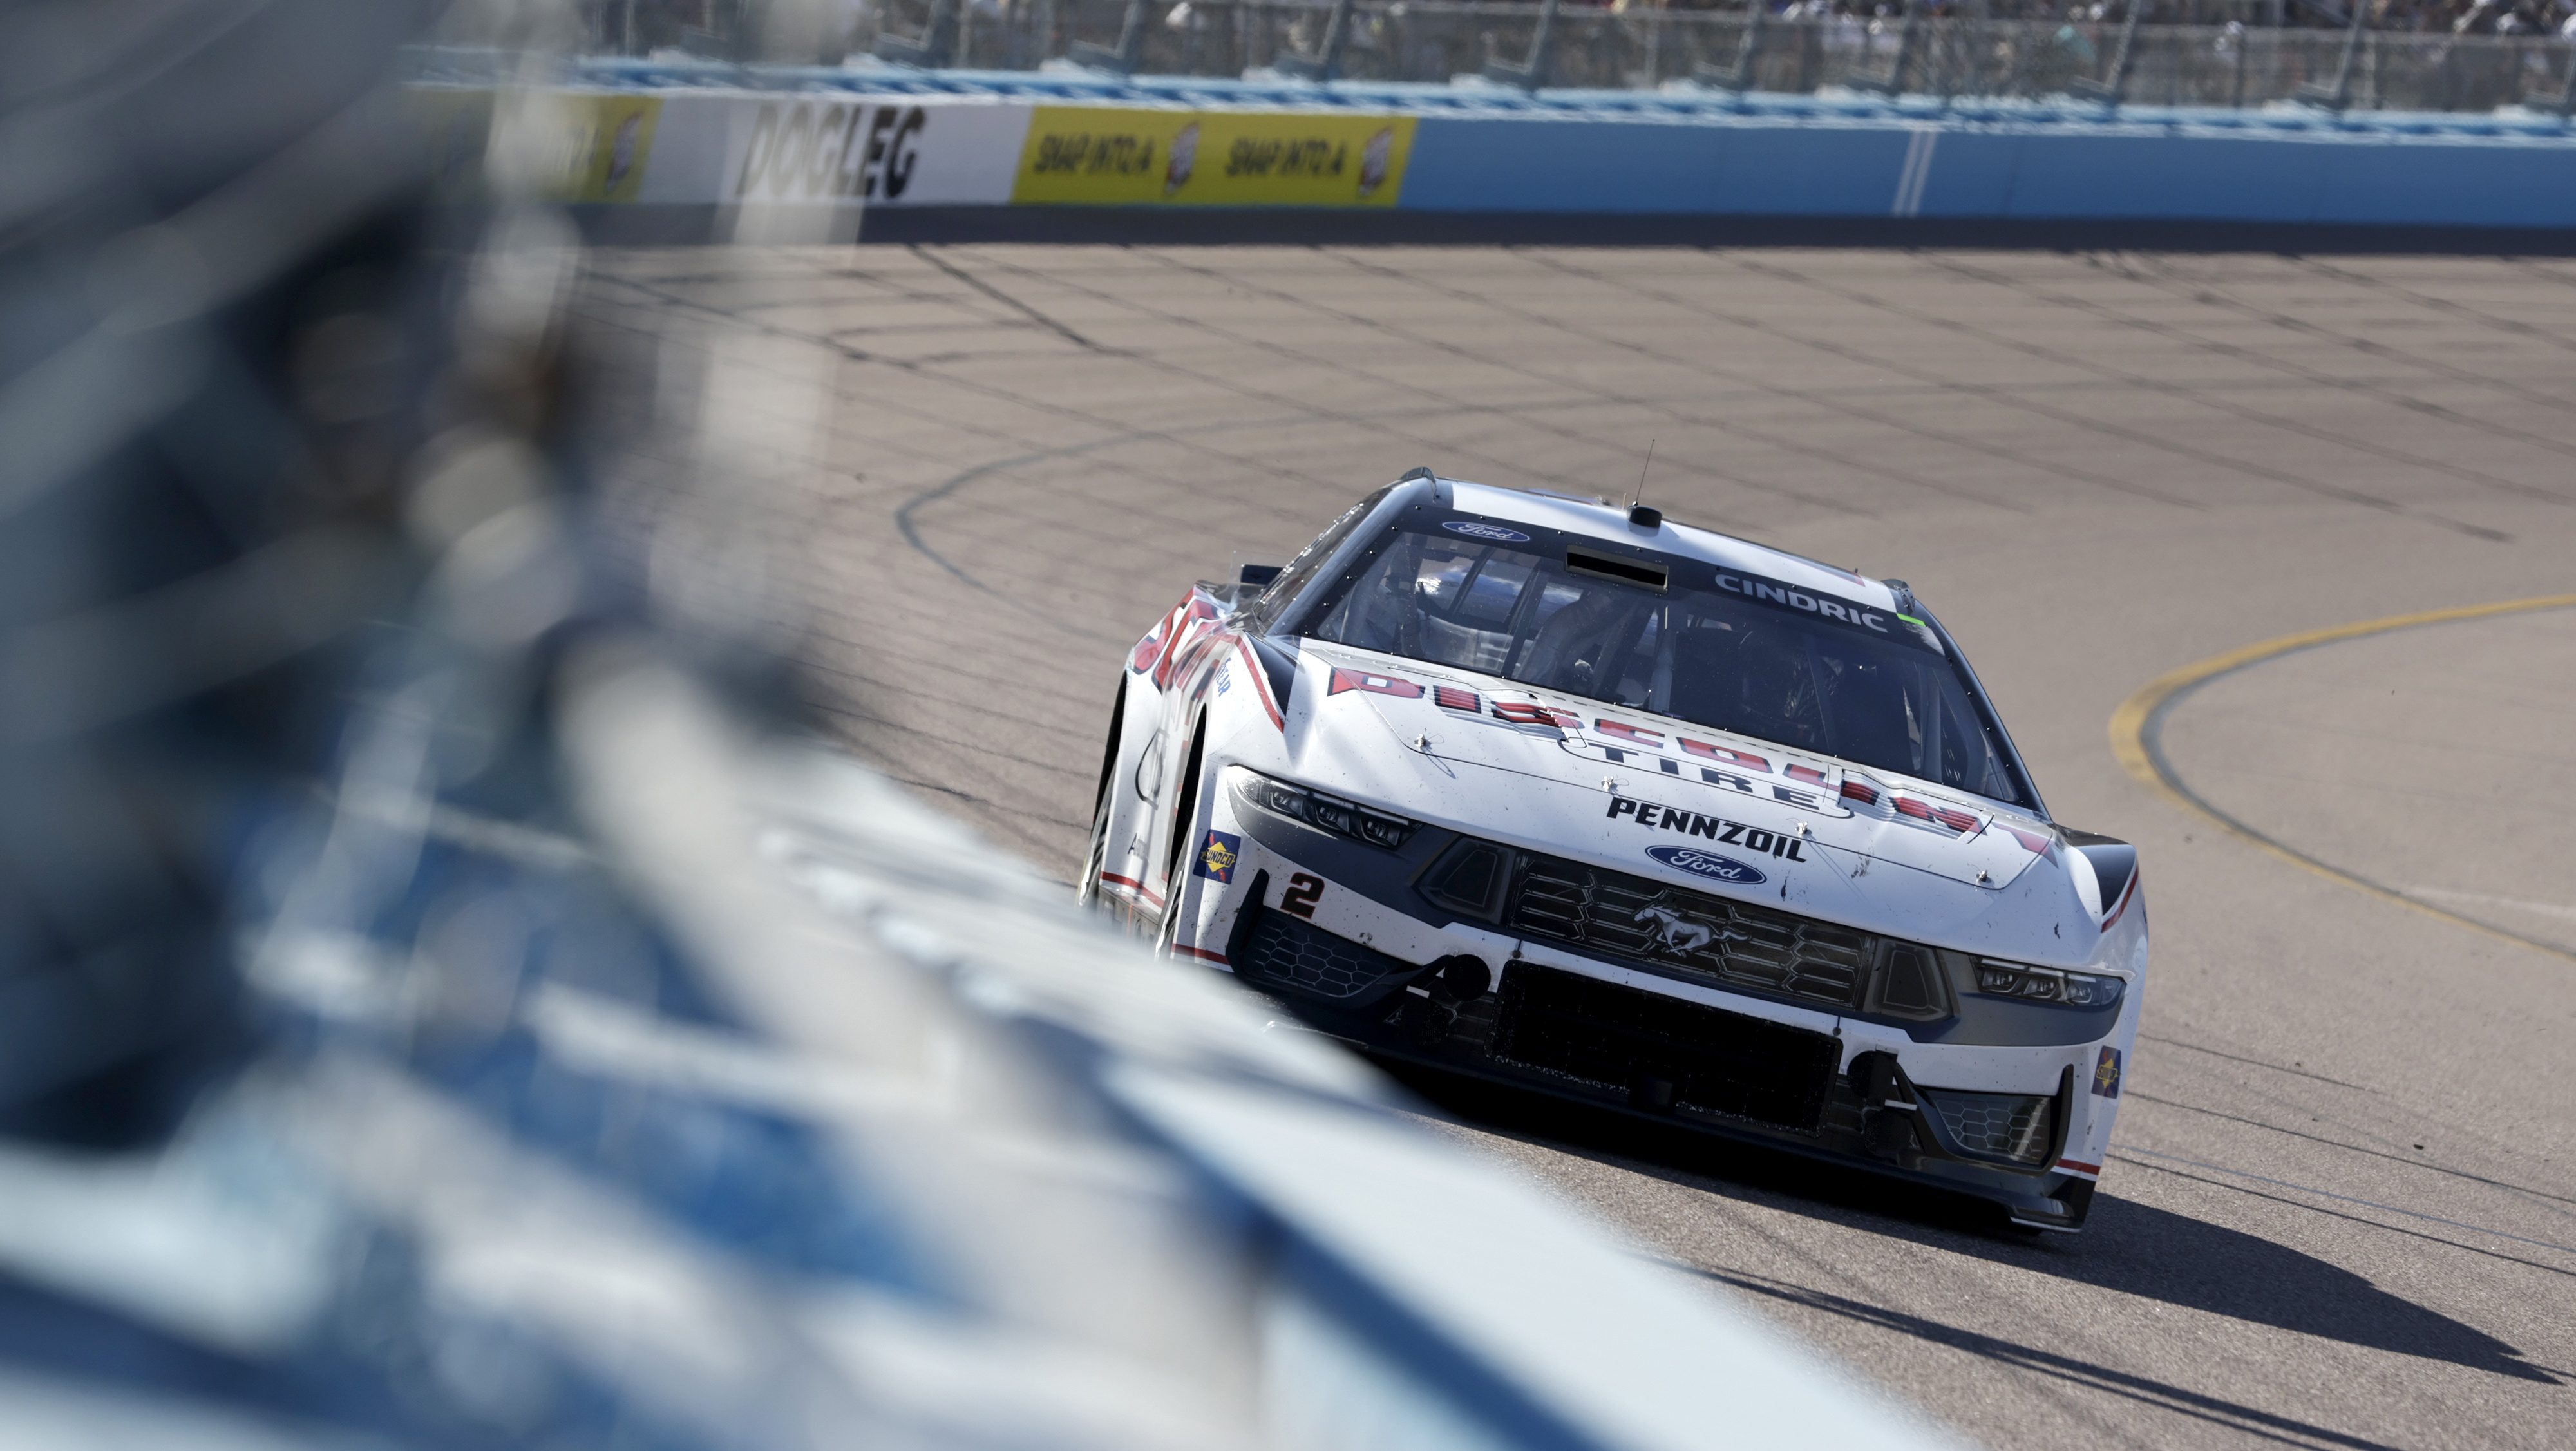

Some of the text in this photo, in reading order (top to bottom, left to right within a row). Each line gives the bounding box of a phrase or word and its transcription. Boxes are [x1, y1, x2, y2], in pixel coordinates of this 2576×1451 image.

[739, 104, 927, 198] DOGLEG
[1457, 522, 1513, 540] Ford
[1714, 573, 1888, 634] CINDRIC
[1587, 741, 1820, 811] TIRE
[1204, 848, 1236, 867] SUNOCO
[1605, 796, 1808, 864] PENNZOIL
[1669, 849, 1743, 880] Ford
[1280, 871, 1325, 920] 2
